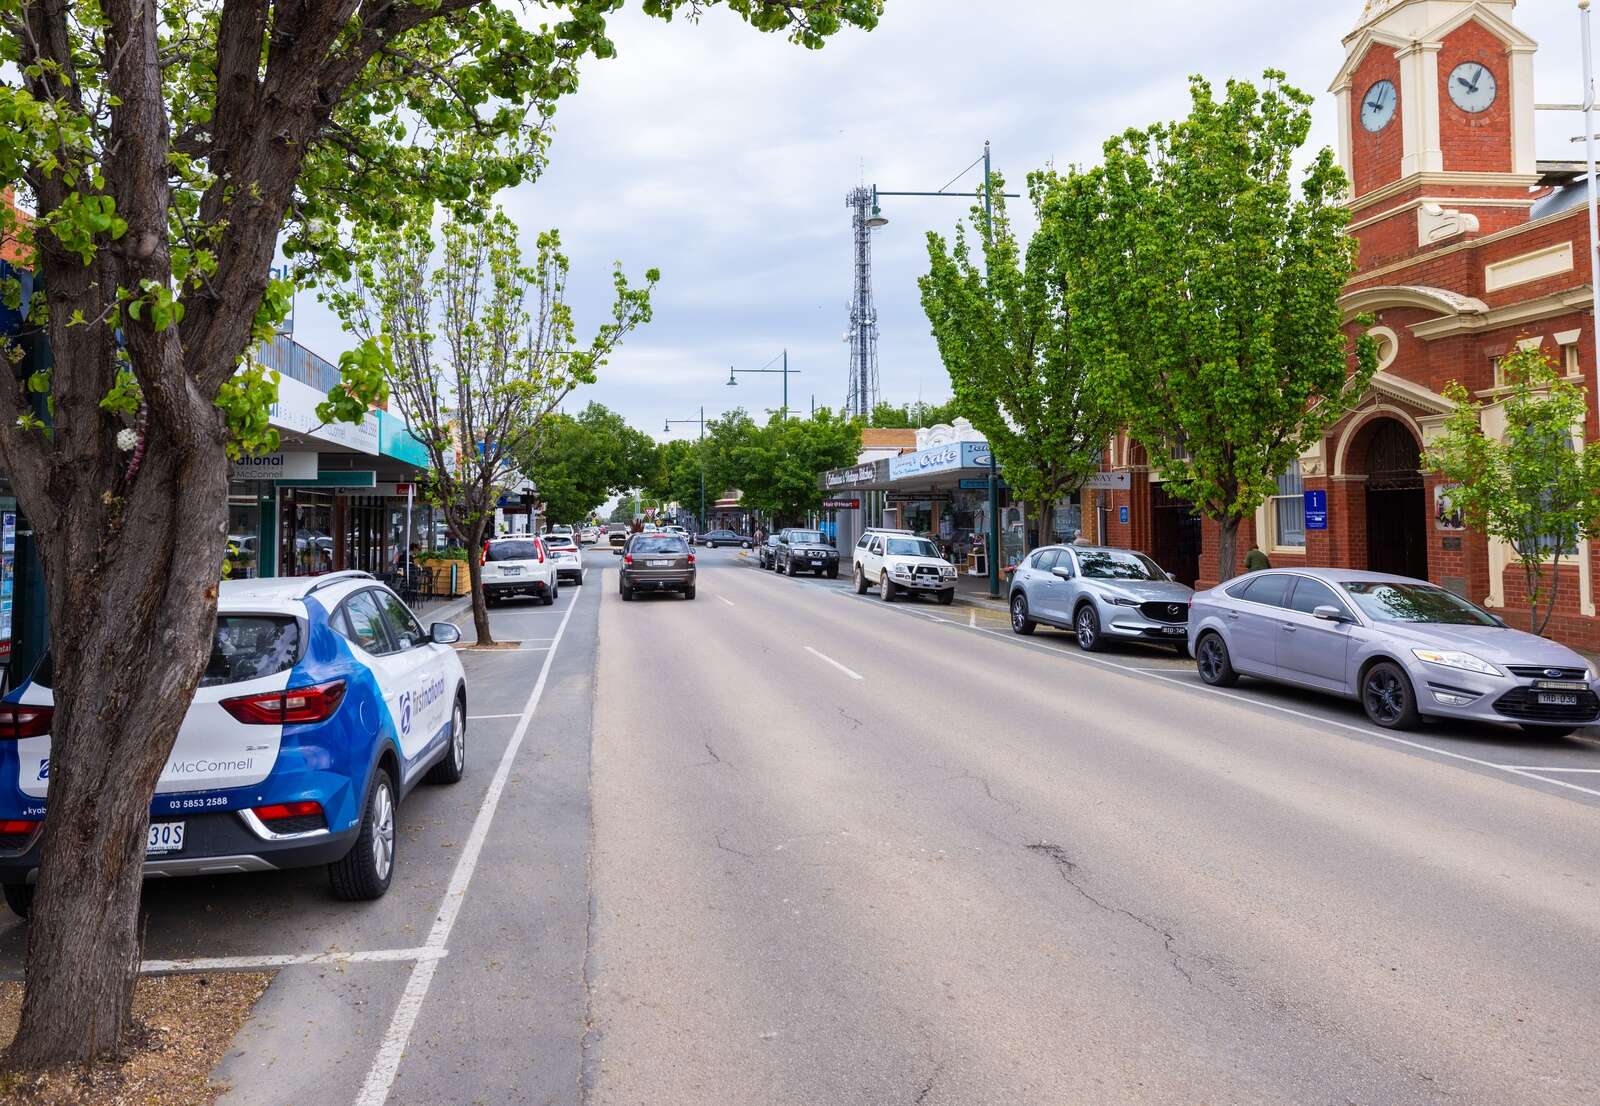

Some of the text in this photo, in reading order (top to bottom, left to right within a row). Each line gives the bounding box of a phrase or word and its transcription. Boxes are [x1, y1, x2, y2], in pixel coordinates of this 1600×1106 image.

[171, 757, 253, 773] McConnell
[169, 797, 228, 809] 03 5853 2588
